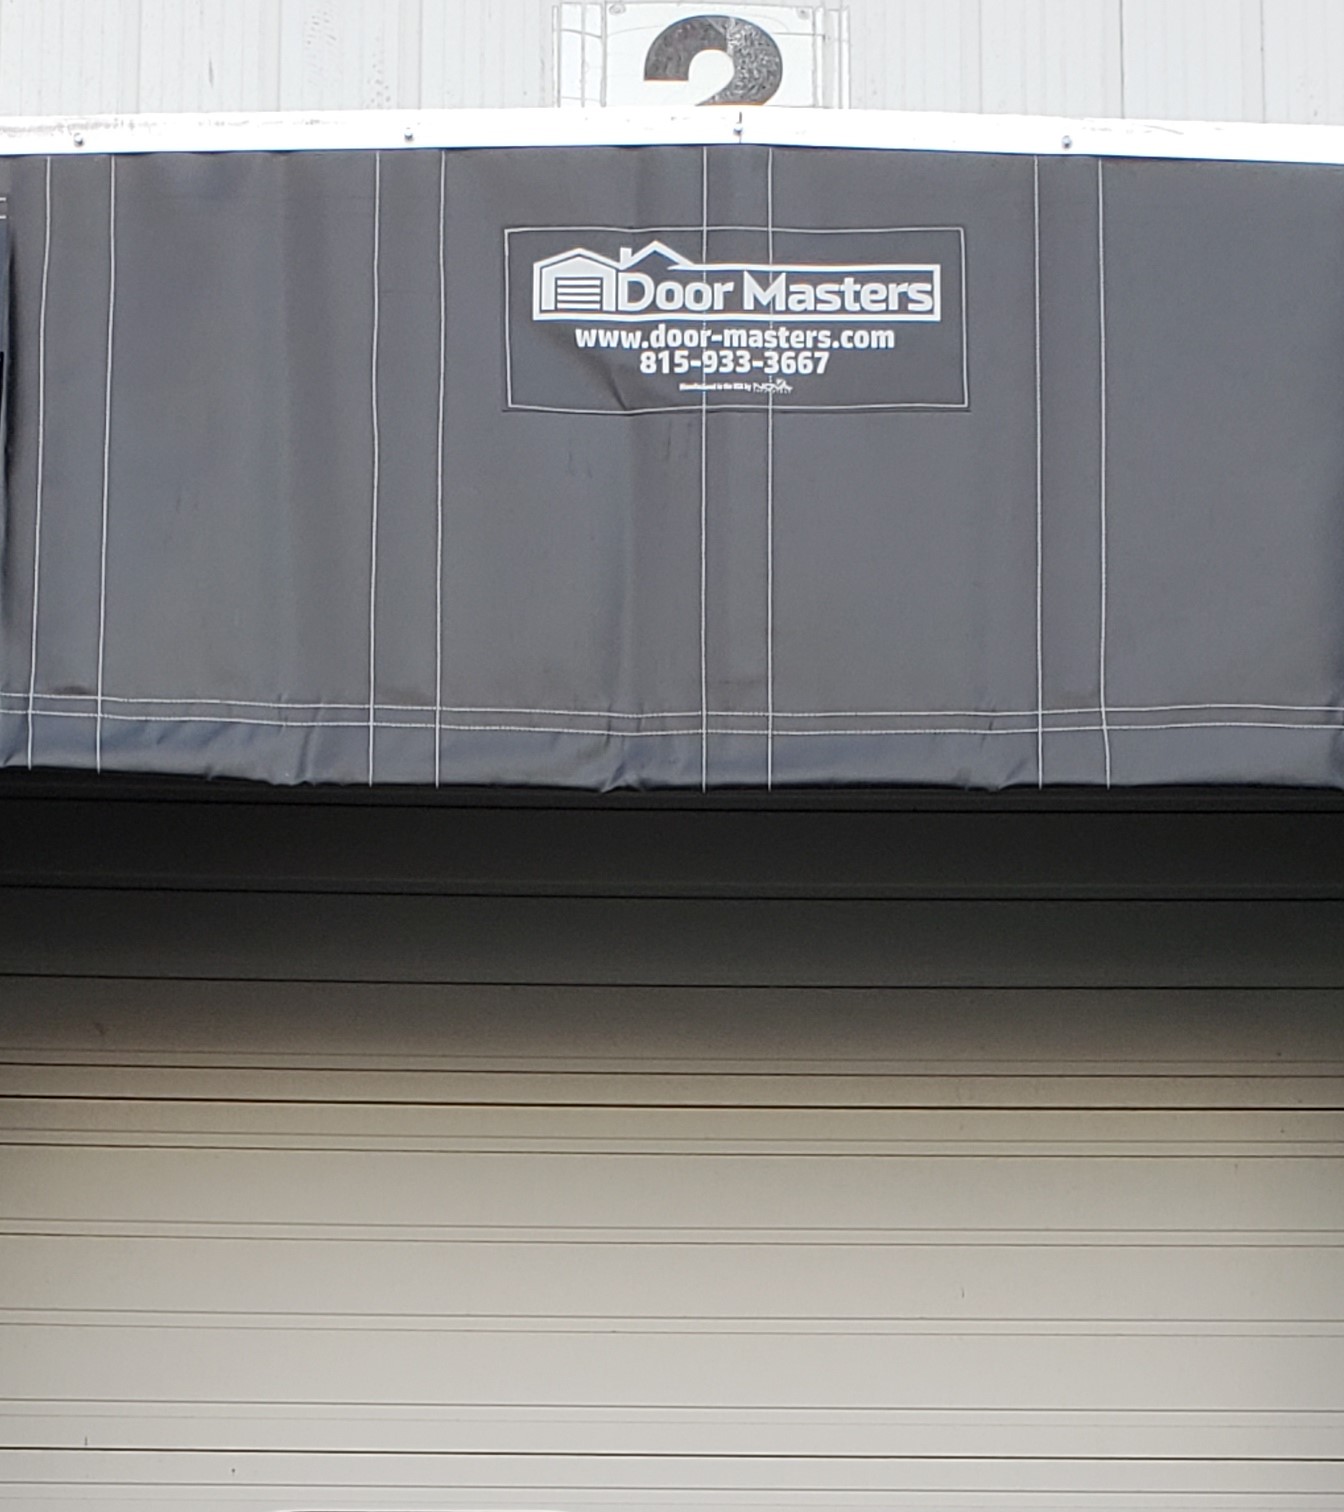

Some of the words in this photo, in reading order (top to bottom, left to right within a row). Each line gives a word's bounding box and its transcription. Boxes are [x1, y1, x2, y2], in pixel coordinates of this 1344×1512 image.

[620, 272, 734, 312] Door
[744, 271, 933, 312] Masters
[575, 324, 896, 349] www.door-masters.com
[640, 351, 830, 375] 815-933-3667
